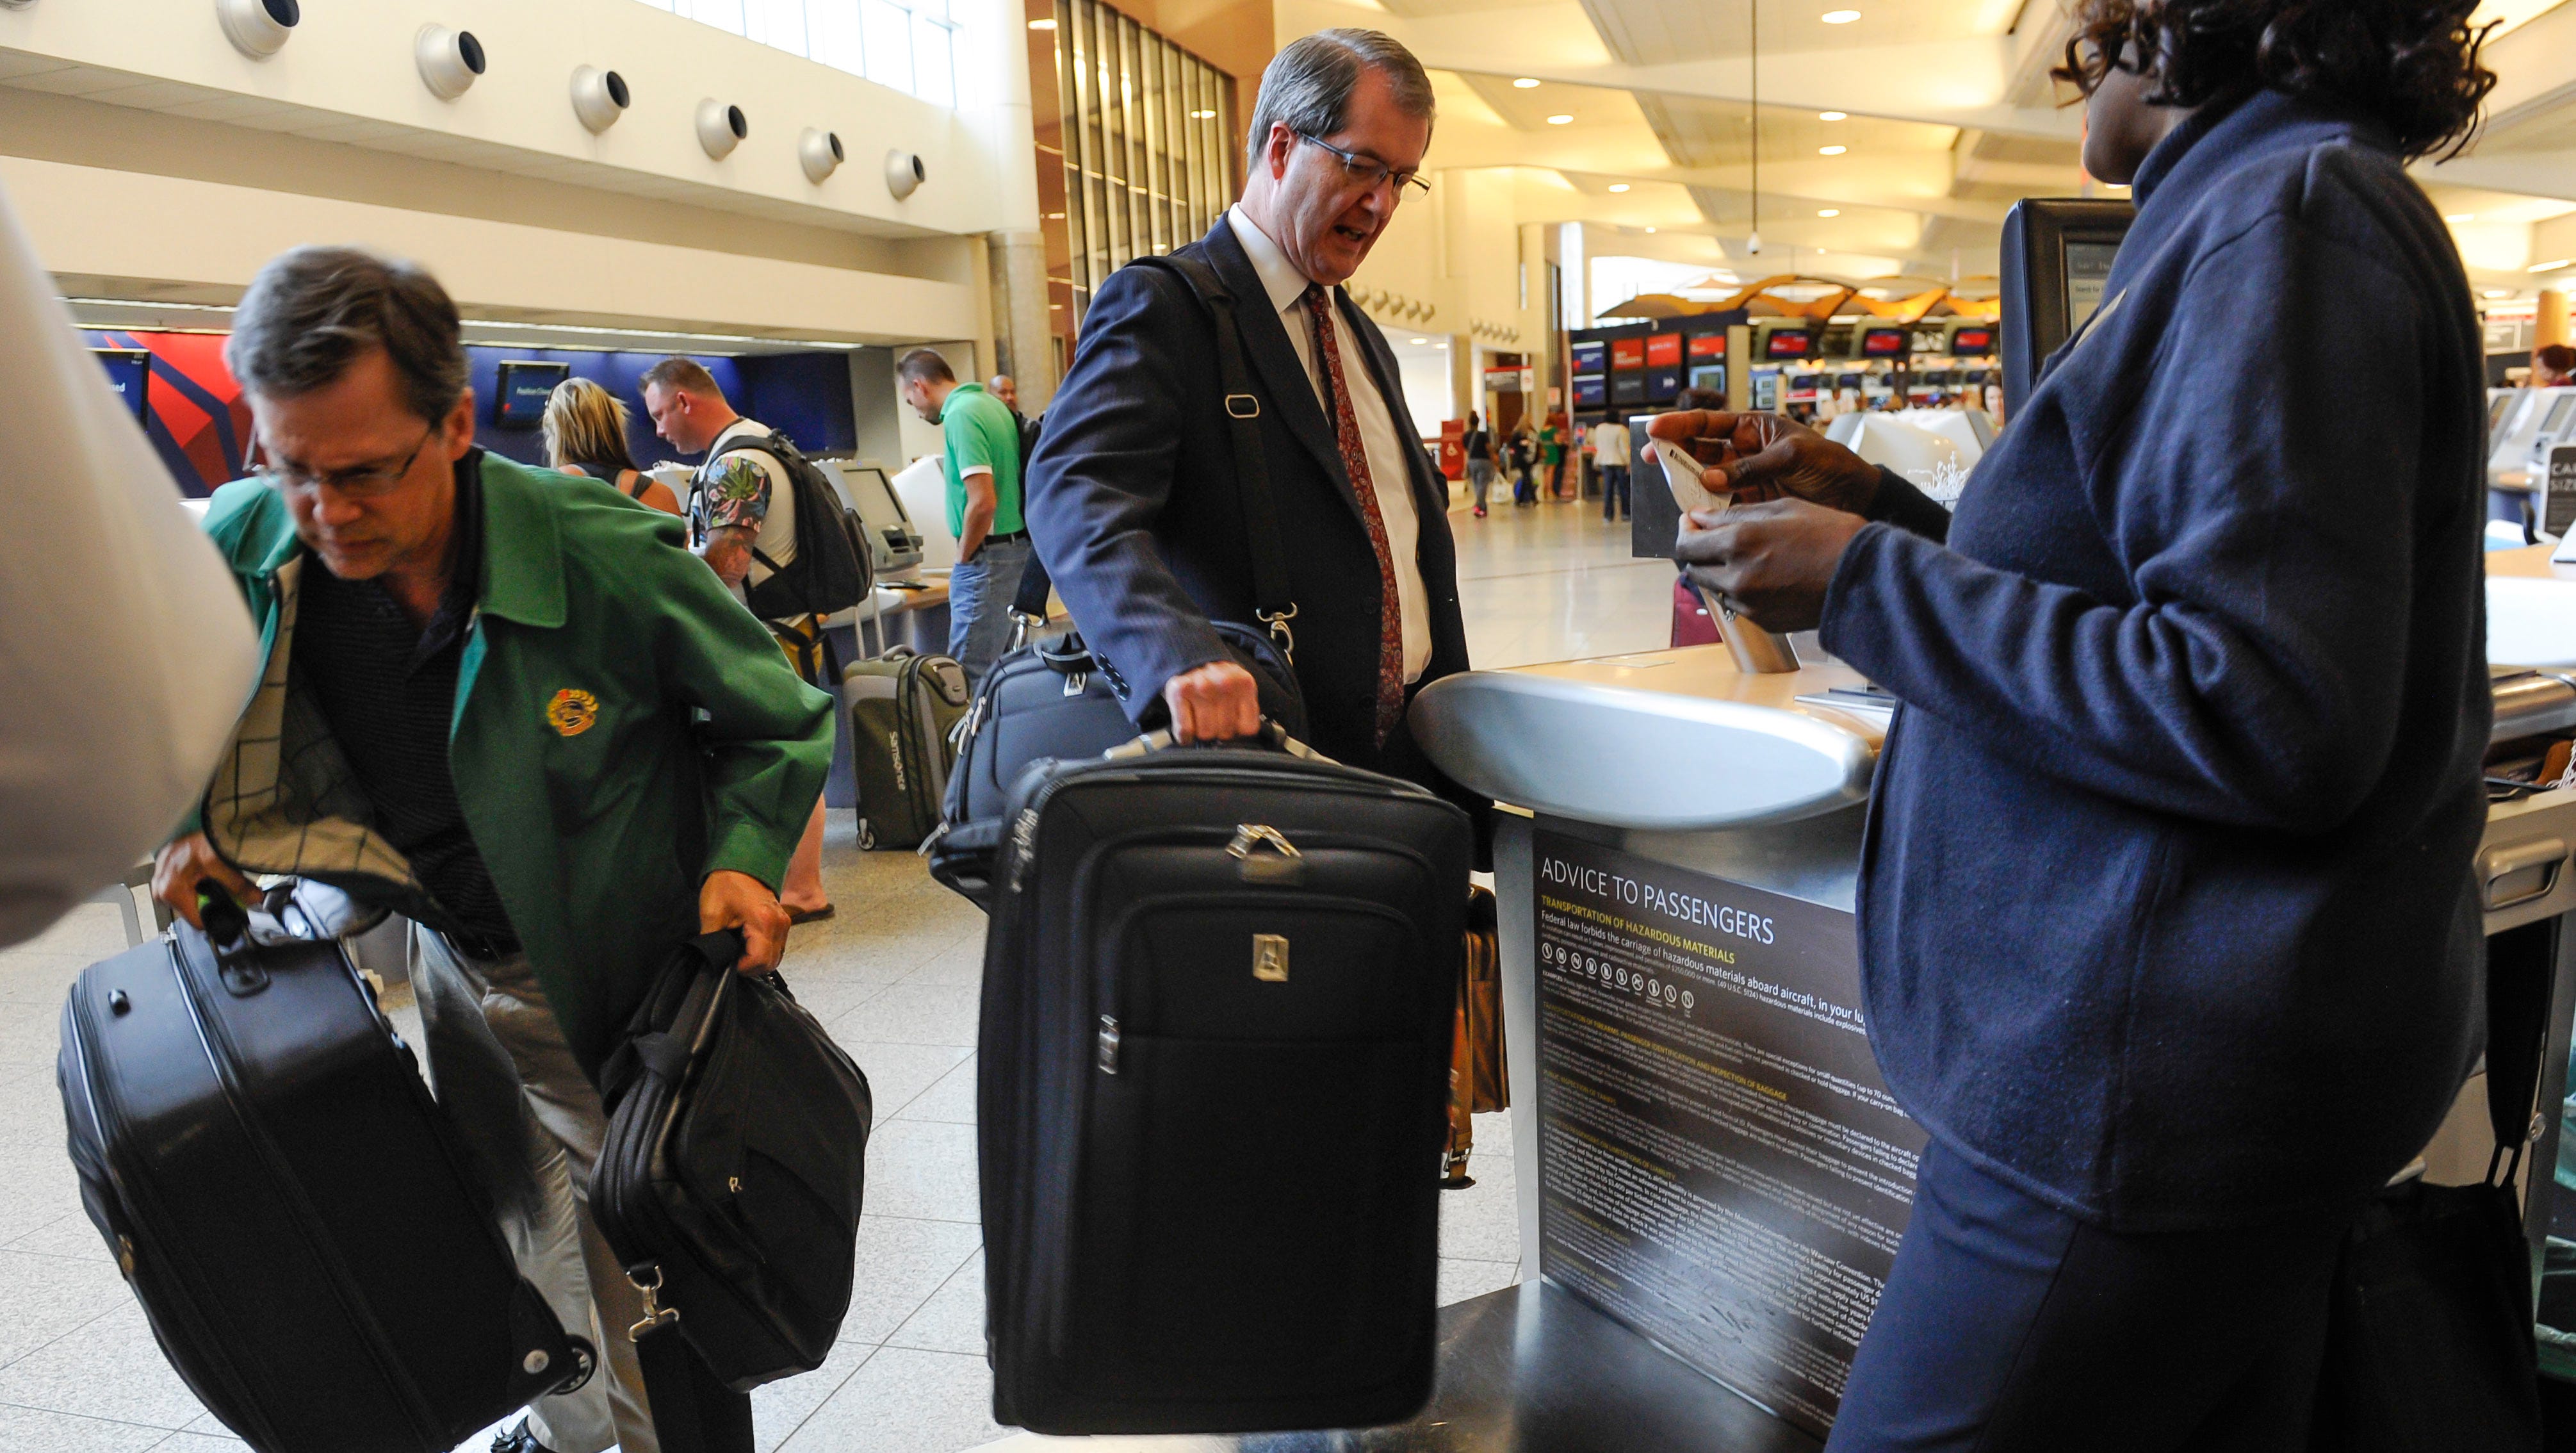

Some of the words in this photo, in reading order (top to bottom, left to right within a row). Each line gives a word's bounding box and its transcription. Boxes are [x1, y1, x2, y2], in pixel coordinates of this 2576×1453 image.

[1541, 857, 1607, 896] ADVICE
[1612, 876, 1638, 904] TO
[1644, 885, 1773, 944] PASSENGERS
[1542, 895, 1611, 925] TRANSPORTATION
[1613, 917, 1624, 929] OF
[1626, 921, 1681, 947] HAZARDOUS
[1683, 939, 1734, 964] MATERIALS
[1542, 910, 1565, 926] Federal
[1567, 917, 1579, 930] law
[1581, 923, 1605, 939] forbids
[1608, 930, 1619, 944] the
[1621, 935, 1651, 956] carriage
[1652, 944, 1661, 957] of
[1663, 948, 1704, 971] hazardous
[1706, 962, 1745, 985] materials
[1747, 974, 1778, 996] aboard
[1781, 985, 1816, 1010] aircraft,
[1818, 996, 1827, 1012] in
[1829, 1003, 1852, 1022] your
[1671, 965, 1695, 979] $250,000
[1717, 980, 1726, 989] (49
[1743, 989, 1758, 999] 5124)
[1759, 994, 1786, 1008] hazardous
[1788, 1003, 1812, 1017] materials
[1814, 1012, 1834, 1024] include
